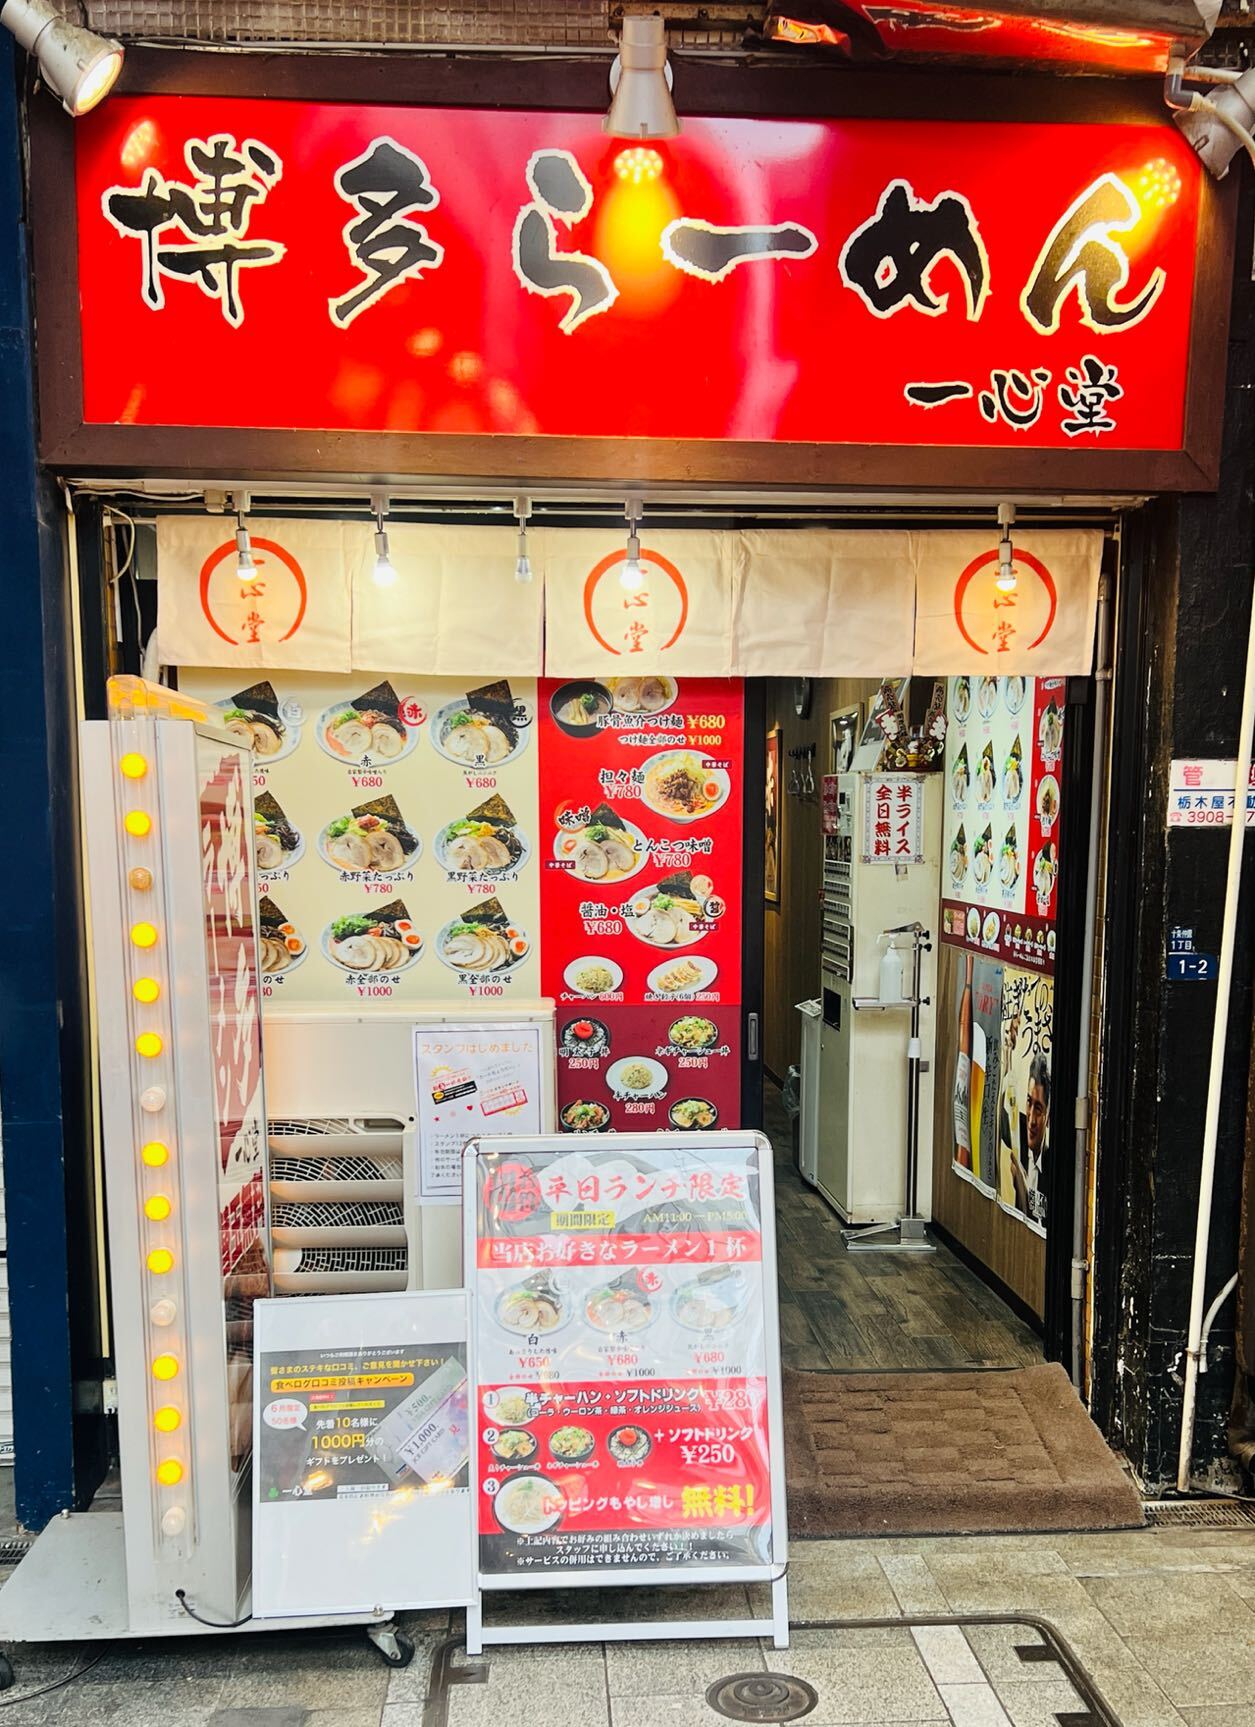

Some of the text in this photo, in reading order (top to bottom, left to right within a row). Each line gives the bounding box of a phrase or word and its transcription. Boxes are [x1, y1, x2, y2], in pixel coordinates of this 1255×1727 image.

[101, 133, 1166, 336] 博多らーめん
[904, 354, 1124, 437] 一心堂
[596, 715, 726, 729] 豚骨魚介つけ麺 ¥680
[618, 733, 722, 746] つけ麺全部のせ ¥1000
[360, 755, 372, 767] 赤
[474, 754, 486, 766] 黒
[351, 776, 382, 787] ¥680
[600, 769, 646, 784] 担々麺
[1183, 765, 1203, 786] 管
[466, 777, 497, 788] ¥680
[604, 784, 642, 798] ¥780
[874, 784, 893, 856] 全日無料
[896, 785, 912, 855] 半ライス
[633, 838, 713, 854] とんこつ味噌
[654, 853, 691, 867] ¥780
[339, 870, 415, 882] 赤野菜たっぷり
[446, 871, 519, 882] 黒野菜たっぷり
[363, 883, 393, 893] ¥780
[467, 883, 496, 893] ¥780
[580, 902, 636, 918] 醤油・塩
[584, 920, 622, 936] ¥680
[1178, 959, 1208, 974] 1-2
[263, 975, 285, 984] のせ
[345, 974, 401, 985] 赤全部のせ
[457, 974, 513, 985] 黒全部のせ
[357, 986, 393, 996] ¥1000
[469, 986, 504, 996] ¥1000
[568, 1057, 599, 1069] 250円
[678, 1057, 709, 1068] 250円
[544, 1173, 746, 1204] 平日ランチ限定
[527, 1333, 539, 1346] 白
[518, 1355, 550, 1368] ¥650
[607, 1353, 638, 1365] ¥680
[694, 1351, 725, 1363] ¥680
[626, 1367, 656, 1378] ¥1000
[681, 1445, 735, 1465] ¥250
